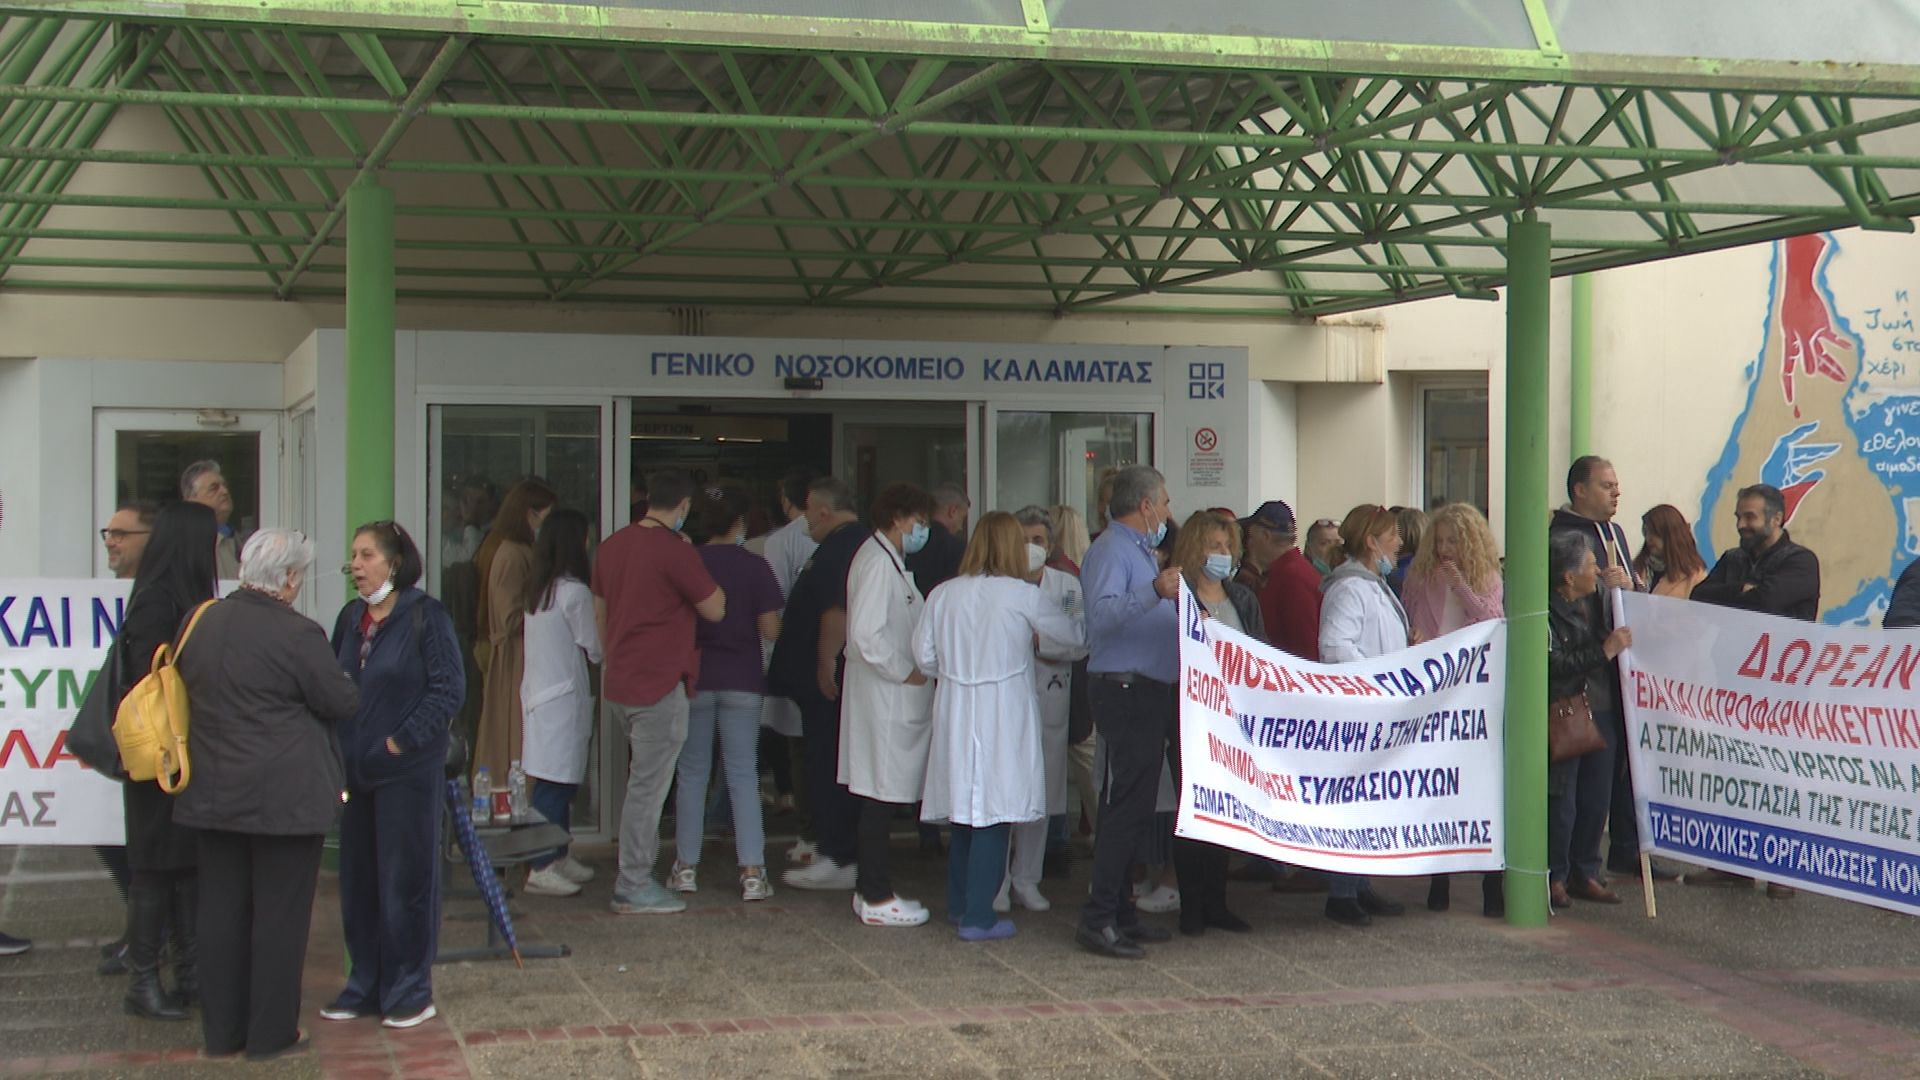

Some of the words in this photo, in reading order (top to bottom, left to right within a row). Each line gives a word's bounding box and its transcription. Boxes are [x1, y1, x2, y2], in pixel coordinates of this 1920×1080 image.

[651, 352, 755, 377] ΓΕΝΙΚΟ
[774, 354, 965, 381] ΝΟΣΟΚΟΜΕΙΟ
[982, 358, 1153, 384] ΚΑΛΑΜΑΤΑΣ
[1296, 670, 1382, 696] ΥΓΕΙΑ
[1373, 667, 1425, 697] ΓΙΑ
[1423, 642, 1491, 693] ΟΛΟΥΣ
[1737, 632, 1920, 690] ΔΩΡΕΑΝ
[0, 668, 101, 709] ΥΜ
[1631, 670, 1669, 711] ΕΙΑ
[1664, 678, 1696, 719] ΚΑΙ
[1259, 717, 1368, 752] ΠΕΡΙΘΑΛΨΗ
[1370, 722, 1383, 752] &
[1384, 716, 1423, 749] ΣΤΗΝ
[1421, 709, 1488, 742] ΕΡΓΑΣΙΑ
[1657, 724, 1765, 769] ΣΤΑΜΑΤΗΣΕΙ
[1760, 745, 1789, 773] ΤΟ
[1788, 750, 1871, 786] ΚΡΑΤΟΣ
[1869, 759, 1906, 792] ΝΑ
[1299, 767, 1460, 805] ΣΥΜΒΑΣΙΟΥΧΩΝ
[1659, 766, 1694, 799] ΤΗΝ
[1699, 773, 1801, 819] ΠΡΟΣΤΑΣΙΑ
[1808, 791, 1843, 826] ΤΗΣ
[1847, 798, 1913, 840] ΥΓΕΙΑΣ
[1402, 821, 1492, 849] ΚΑΛΑΜΑΤΑΣ
[1651, 811, 1760, 861] ΤΑΞΙΟΥΧΙΚΕΣ
[1763, 834, 1878, 887] ΟΡΓΑΝΩΣΕΙΣ
